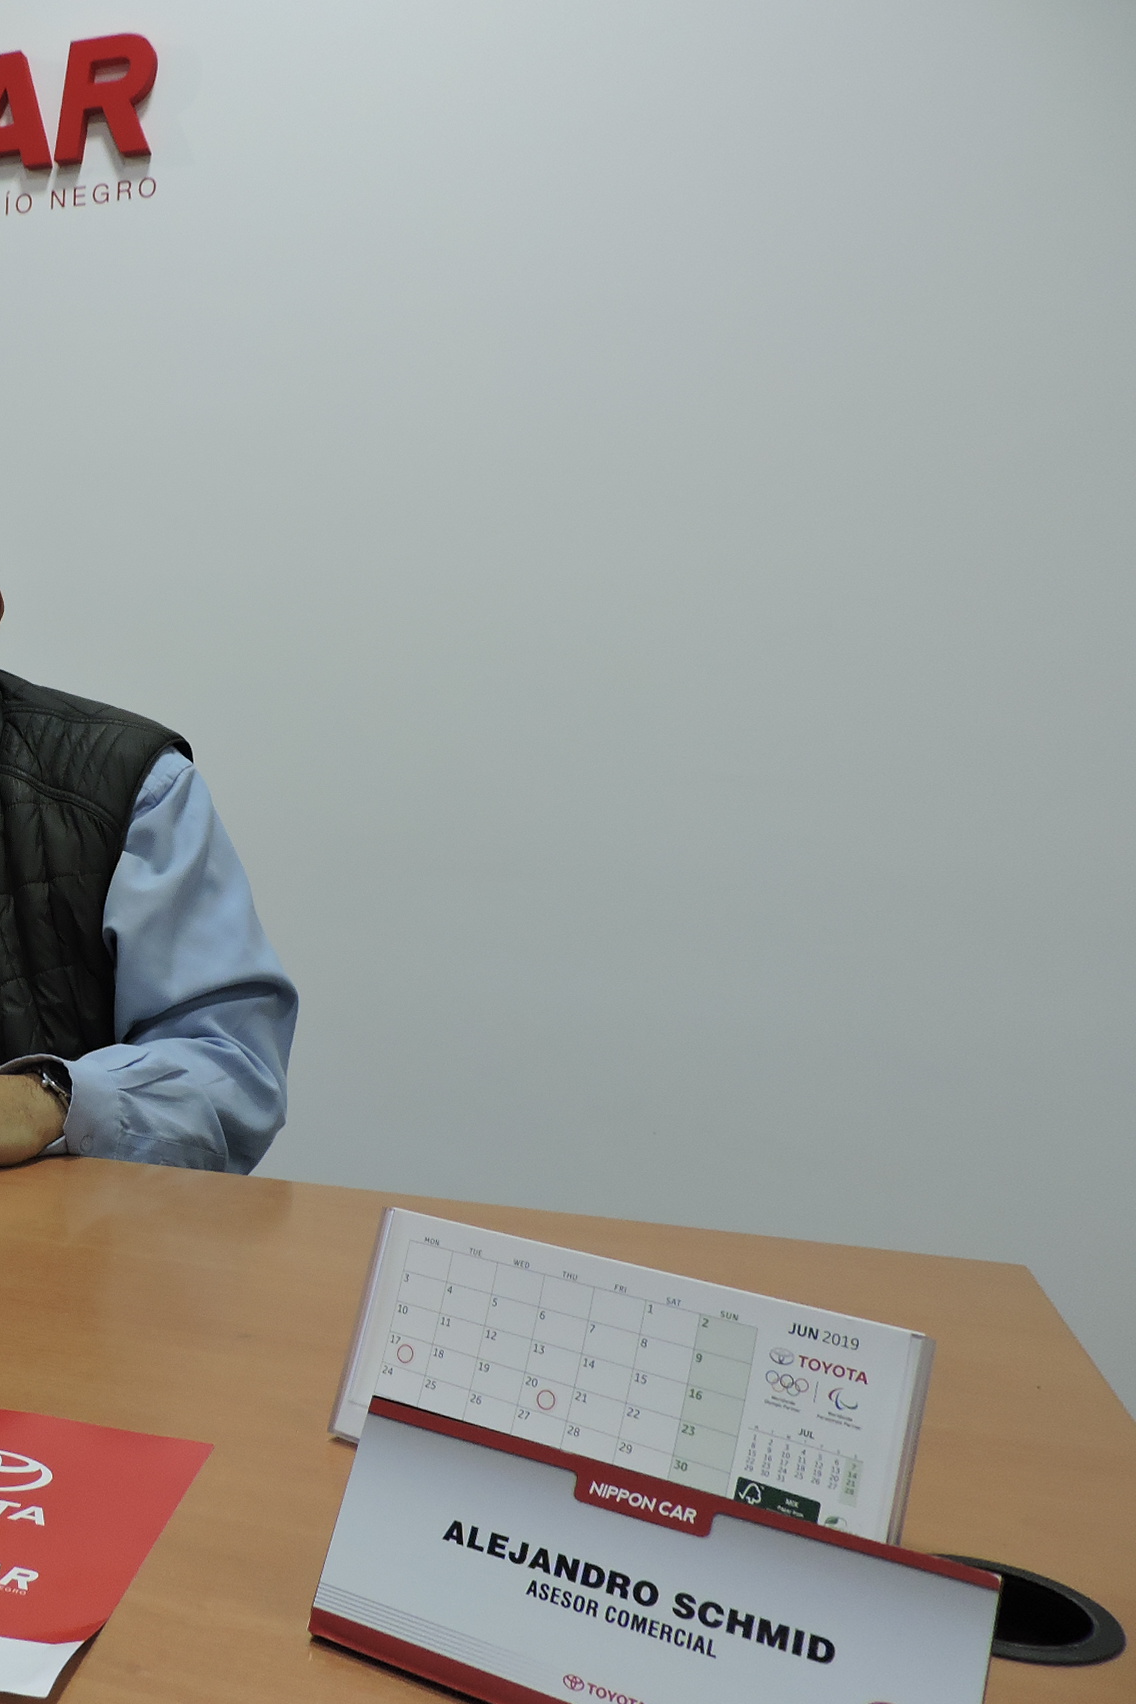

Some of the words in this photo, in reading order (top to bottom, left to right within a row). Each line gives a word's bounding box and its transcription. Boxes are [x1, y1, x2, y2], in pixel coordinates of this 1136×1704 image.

[50, 177, 157, 208] NEGRO
[424, 1236, 440, 1247] MON
[469, 1248, 483, 1257] TUE
[513, 1259, 530, 1269] WED
[562, 1271, 578, 1281] THU
[614, 1284, 627, 1294] FRI
[666, 1297, 681, 1307] SAT
[720, 1310, 739, 1322] SUN
[403, 1273, 410, 1283] 3
[447, 1286, 453, 1294] 4
[492, 1298, 498, 1307] 5
[539, 1311, 546, 1320] 6
[589, 1324, 596, 1333] 7
[640, 1338, 648, 1348] 8
[695, 1353, 703, 1363] 9
[648, 1304, 654, 1315] 1
[701, 1318, 709, 1328] 2
[788, 1323, 819, 1340] JUN
[822, 1330, 860, 1351] 2019
[397, 1304, 408, 1315] 10
[440, 1316, 451, 1327] 11
[484, 1329, 497, 1341] 12
[533, 1343, 545, 1355] 13
[582, 1358, 595, 1369] 14
[634, 1373, 648, 1385] 15
[689, 1388, 703, 1400] 16
[798, 1355, 868, 1385] TOYOTA
[390, 1334, 401, 1345] 17
[433, 1348, 444, 1359] 18
[478, 1362, 490, 1373] 19
[525, 1376, 538, 1388] 20
[575, 1391, 587, 1403] 21
[626, 1407, 640, 1419] 22
[681, 1424, 695, 1436] 23
[382, 1365, 393, 1375] 24
[425, 1379, 437, 1390] 25
[470, 1394, 482, 1405] 26
[517, 1409, 530, 1421] 27
[567, 1425, 580, 1437] 28
[619, 1442, 633, 1454] 29
[674, 1459, 688, 1472] 30
[798, 1428, 815, 1439] JUL
[589, 1481, 657, 1512] NIPPON
[658, 1502, 697, 1524] CAR
[442, 1520, 659, 1607] ALEJANDRO
[672, 1592, 835, 1664] SCHMID
[526, 1580, 599, 1618] ASESOR
[604, 1605, 717, 1659] COMERCIAL
[587, 1682, 645, 1704] TOYOT
